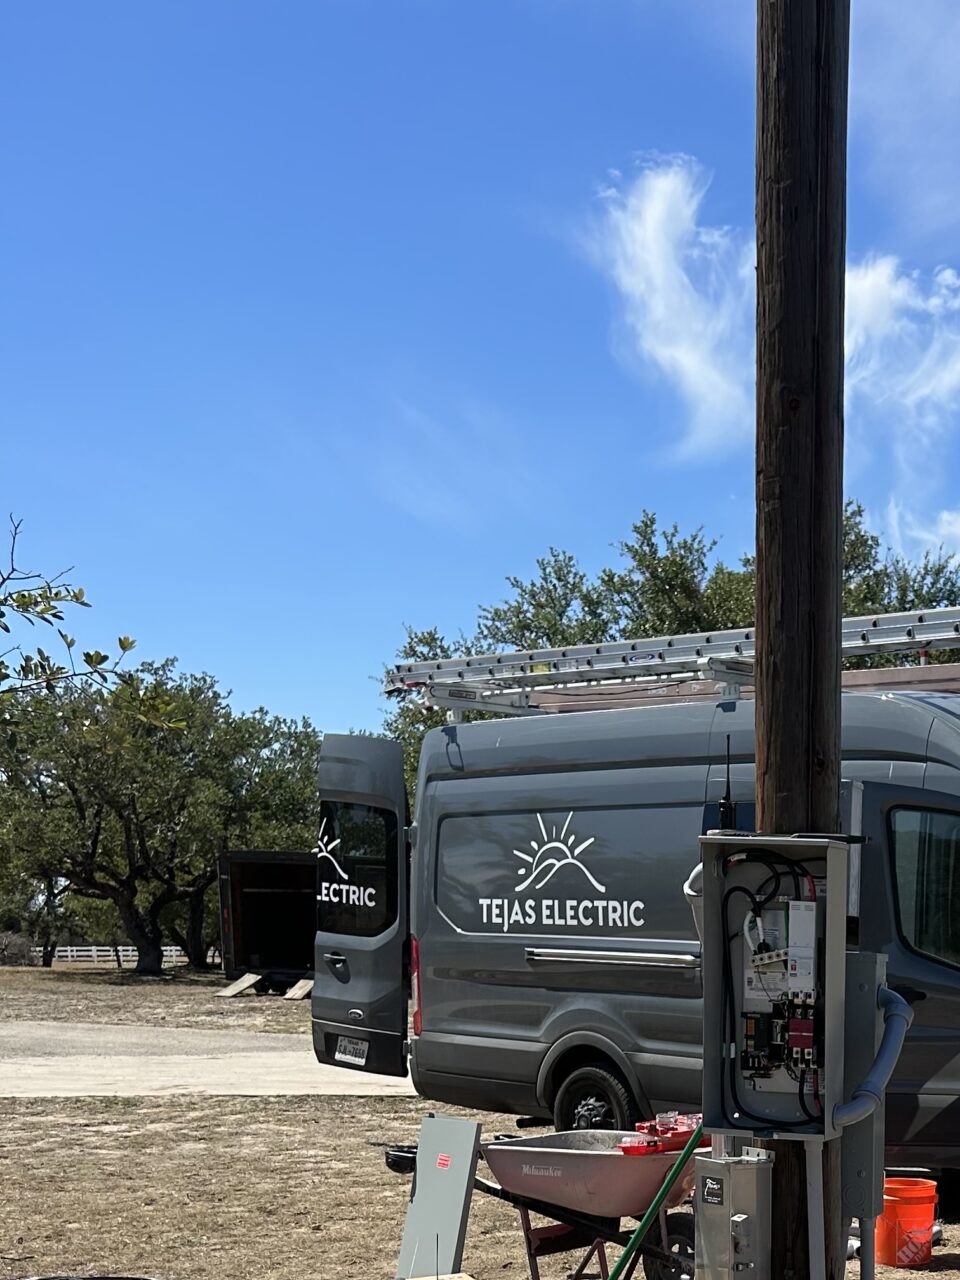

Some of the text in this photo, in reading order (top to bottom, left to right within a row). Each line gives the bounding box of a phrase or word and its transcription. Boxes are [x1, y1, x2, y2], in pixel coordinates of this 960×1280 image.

[316, 882, 376, 907] ECTRIC
[479, 898, 645, 932] TEJAS ELECTRIC
